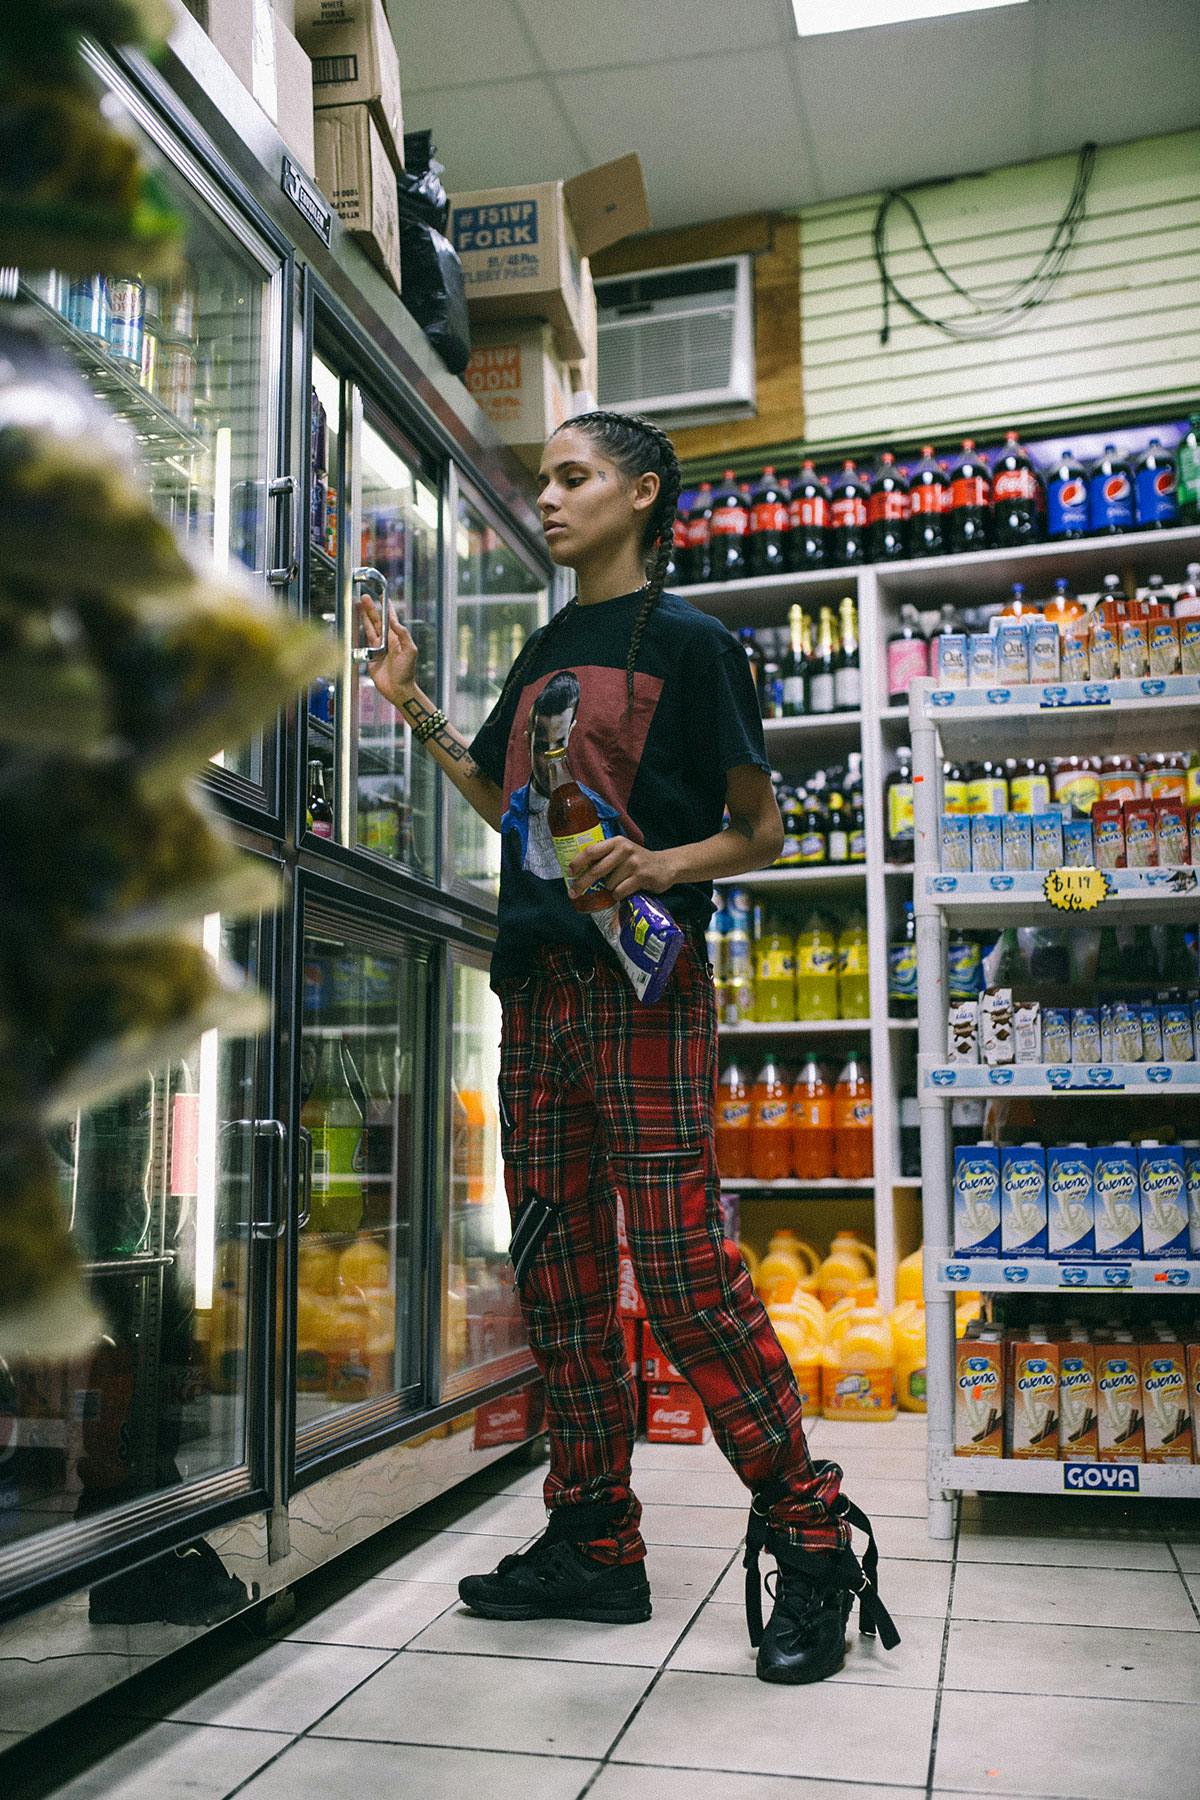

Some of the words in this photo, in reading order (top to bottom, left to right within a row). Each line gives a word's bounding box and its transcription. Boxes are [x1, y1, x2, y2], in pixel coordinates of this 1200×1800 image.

[460, 225, 532, 249] FORK
[1052, 875, 1090, 892] $1.19
[1067, 1467, 1135, 1488] GOYA
